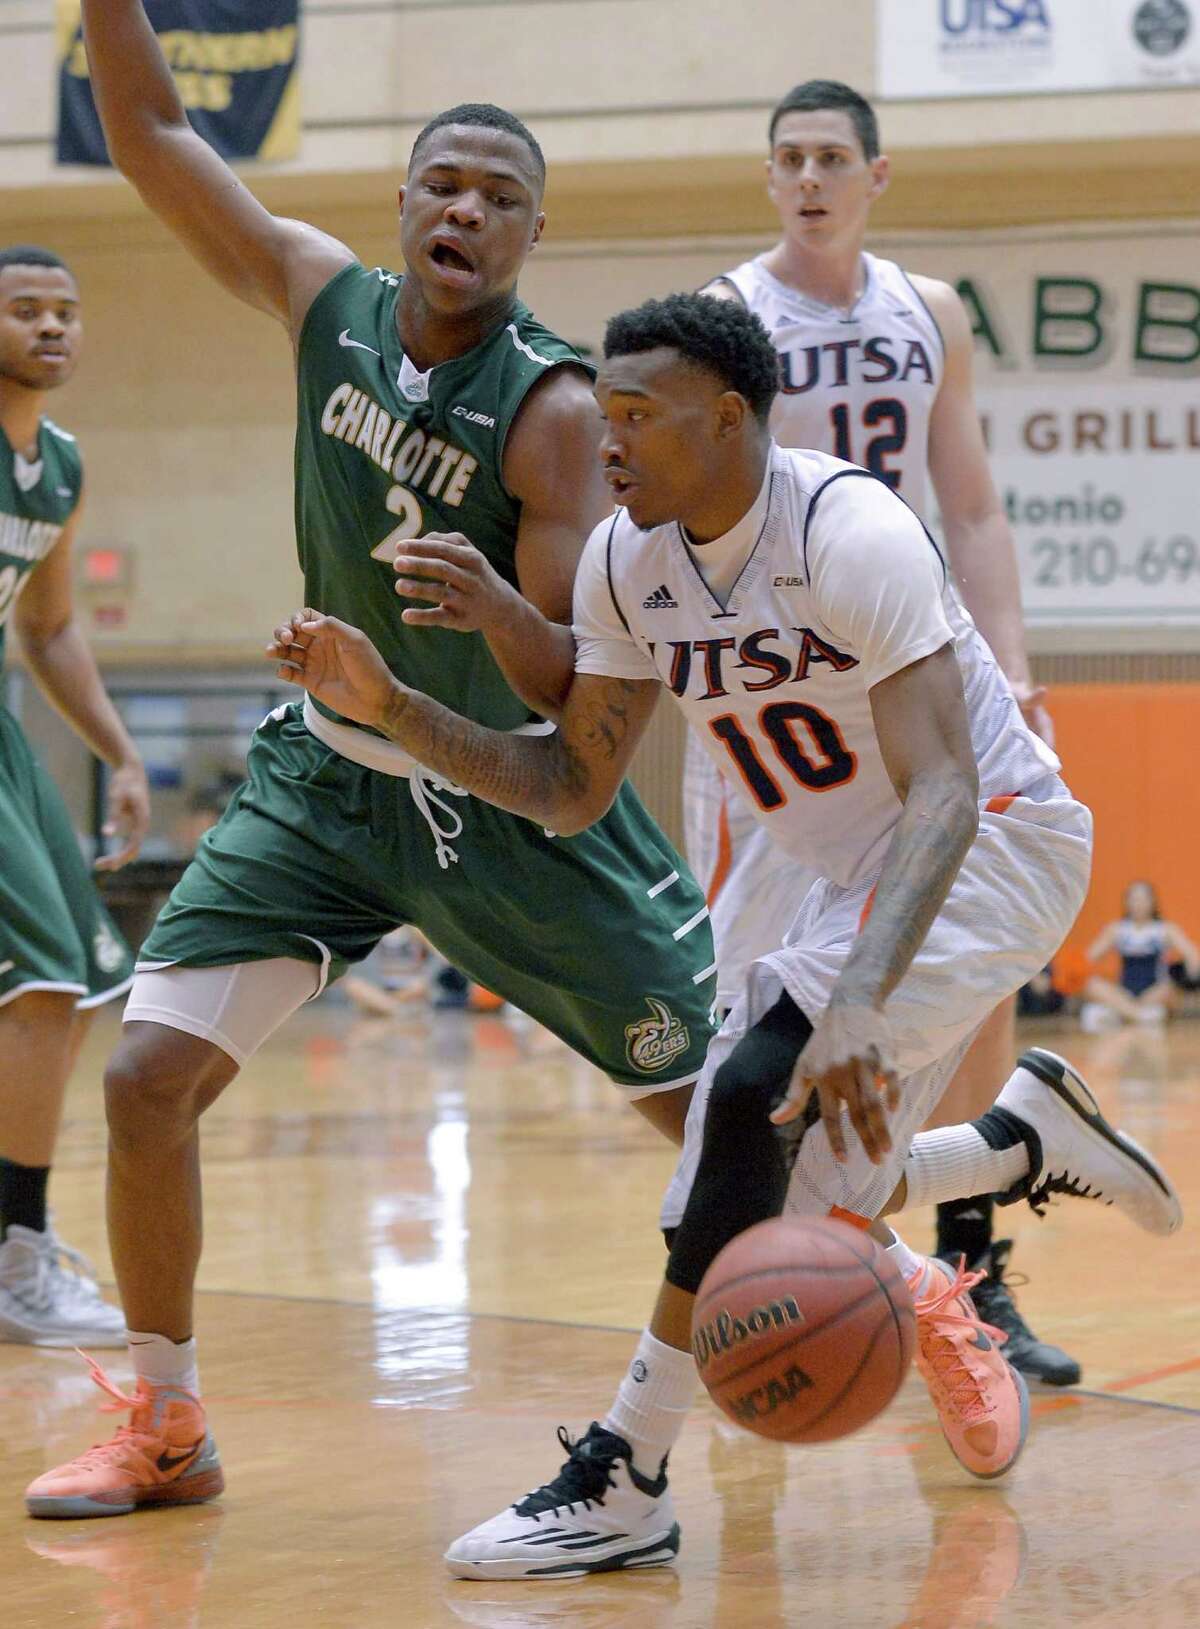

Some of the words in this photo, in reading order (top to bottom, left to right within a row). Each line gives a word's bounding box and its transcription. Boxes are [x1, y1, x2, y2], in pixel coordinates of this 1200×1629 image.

[778, 336, 934, 395] UTSA
[321, 382, 478, 507] CHARLOTTE
[829, 397, 908, 489] 12
[370, 485, 422, 563] 2
[1004, 481, 1125, 525] tonio
[1031, 533, 1200, 588] 210-69
[642, 600, 680, 609] adidas
[642, 627, 860, 701] UTSA
[707, 700, 858, 813] 10
